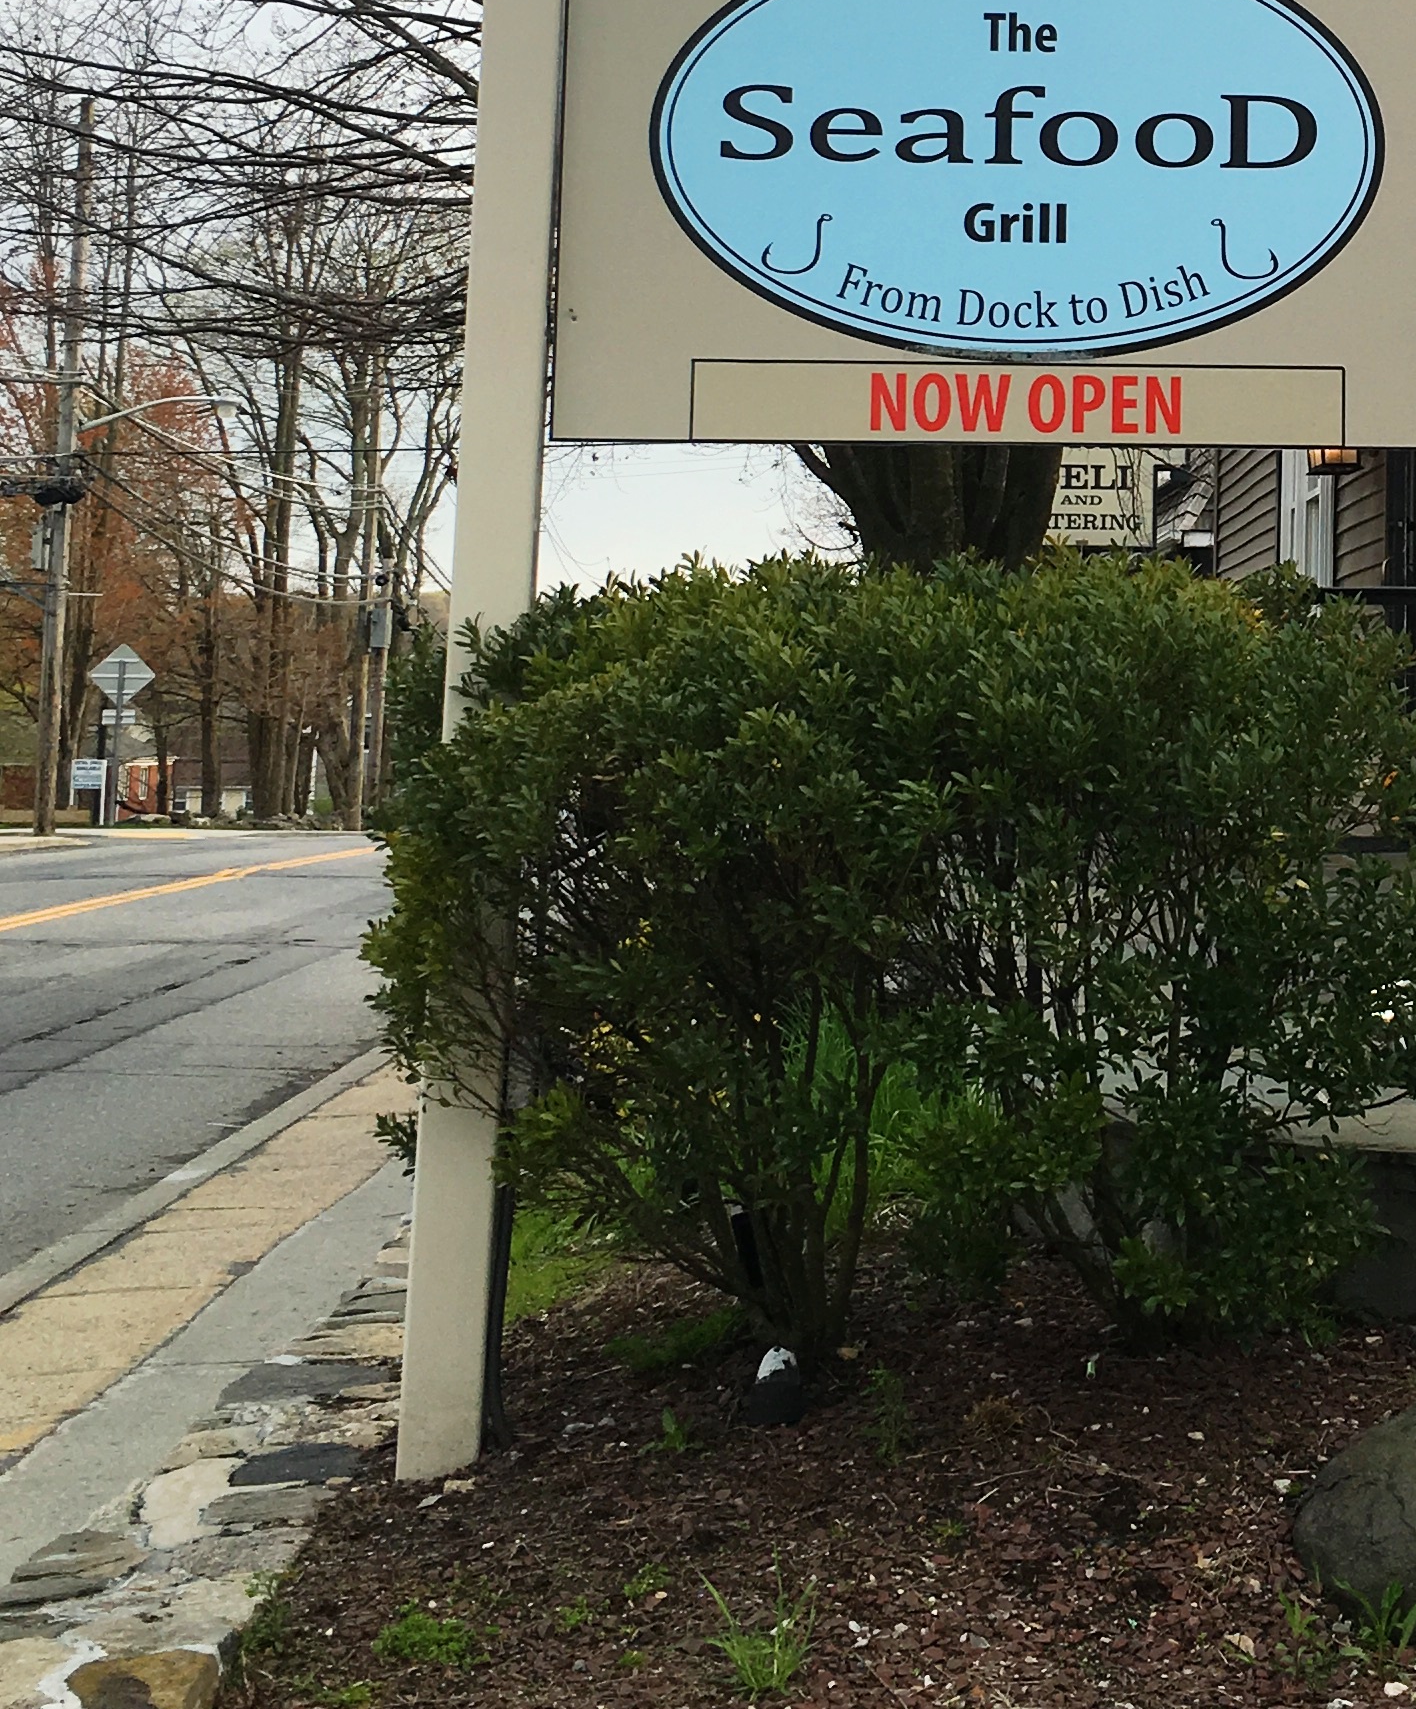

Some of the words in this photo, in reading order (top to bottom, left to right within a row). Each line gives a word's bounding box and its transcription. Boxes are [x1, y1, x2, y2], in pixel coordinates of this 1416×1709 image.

[983, 11, 1058, 53] The
[719, 84, 1318, 169] SeafooD
[963, 202, 1068, 244] Grill
[835, 262, 943, 323] From
[956, 288, 1060, 329] Dock
[1067, 293, 1108, 326] to
[1117, 264, 1212, 320] Dish
[868, 371, 1013, 434] NOW
[1027, 373, 1183, 435] OPEN
[1059, 464, 1134, 490] ELI
[1060, 494, 1103, 506] AND
[1046, 513, 1142, 533] TERING
